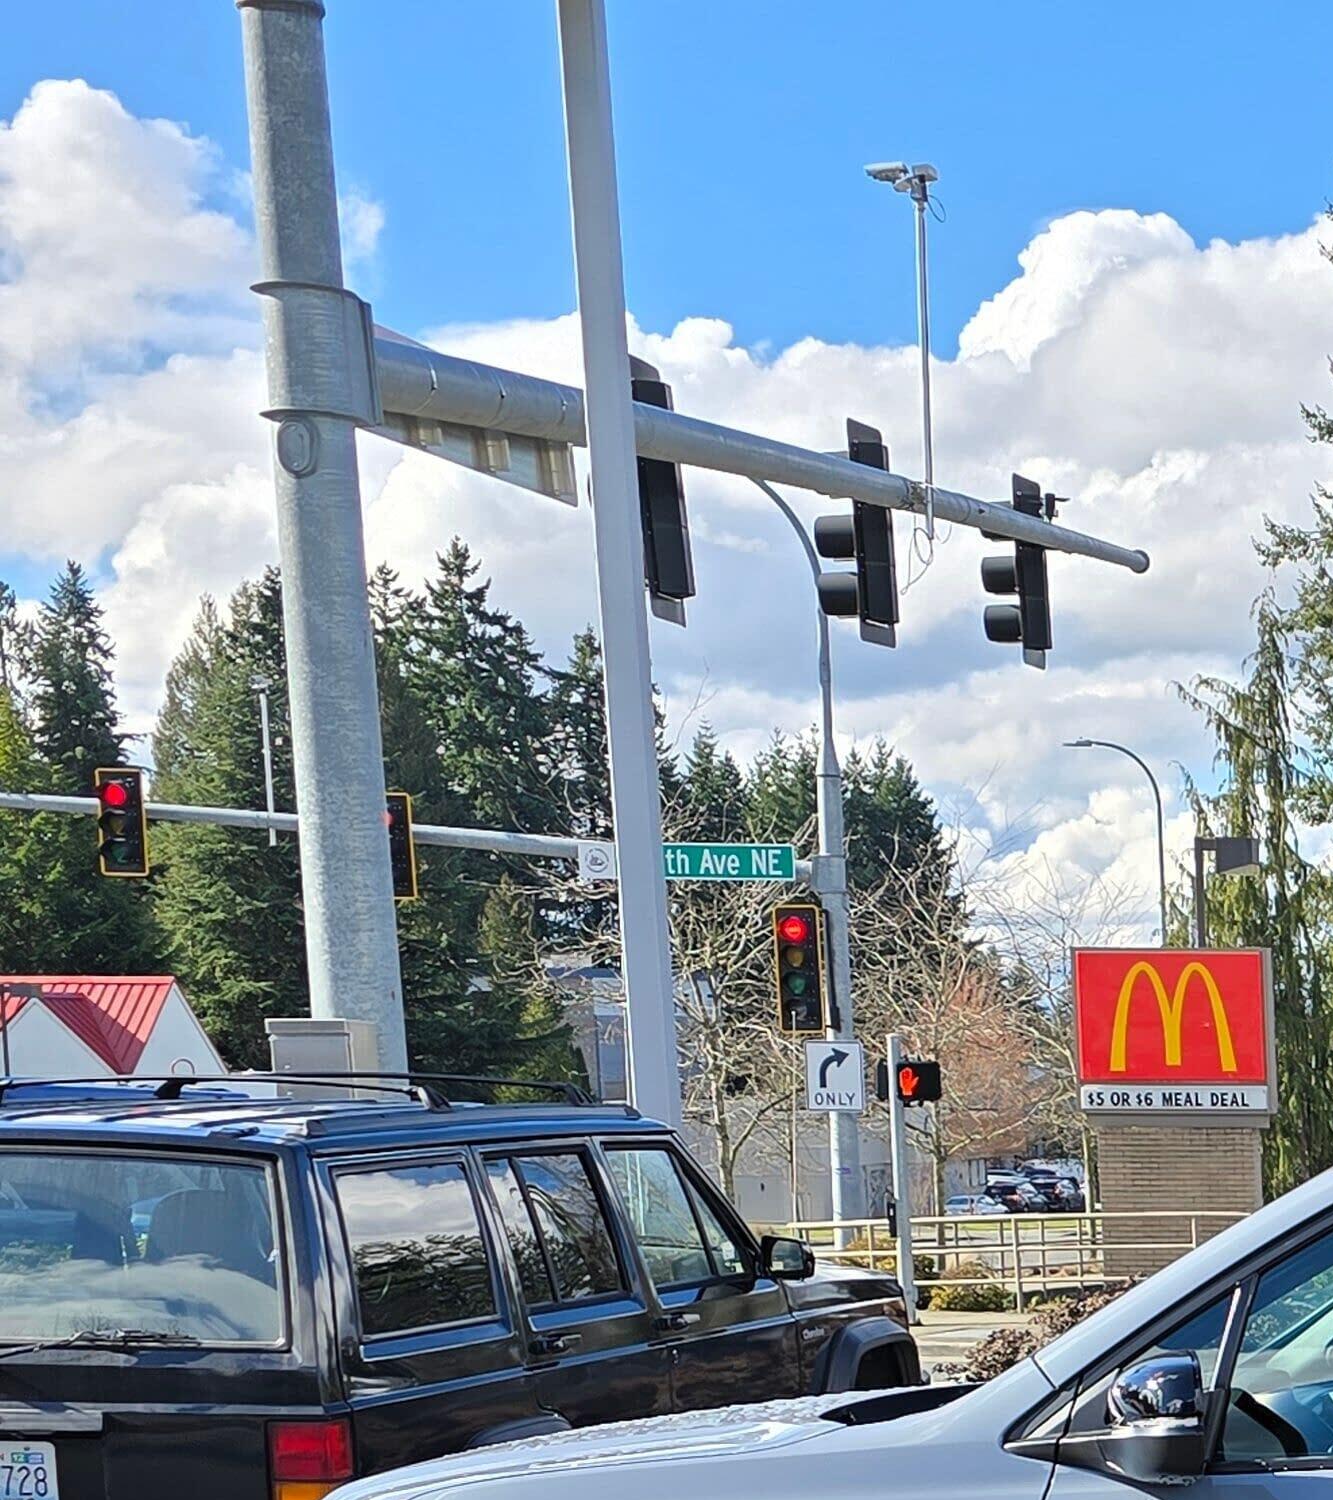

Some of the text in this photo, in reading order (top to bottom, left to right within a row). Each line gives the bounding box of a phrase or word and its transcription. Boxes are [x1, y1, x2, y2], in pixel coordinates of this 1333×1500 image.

[664, 848, 783, 876] th Ave NE
[814, 1091, 855, 1106] ONLY
[1087, 1091, 1250, 1108] $5 OR $6 MEAL DEAL
[0, 1465, 48, 1497] 728
